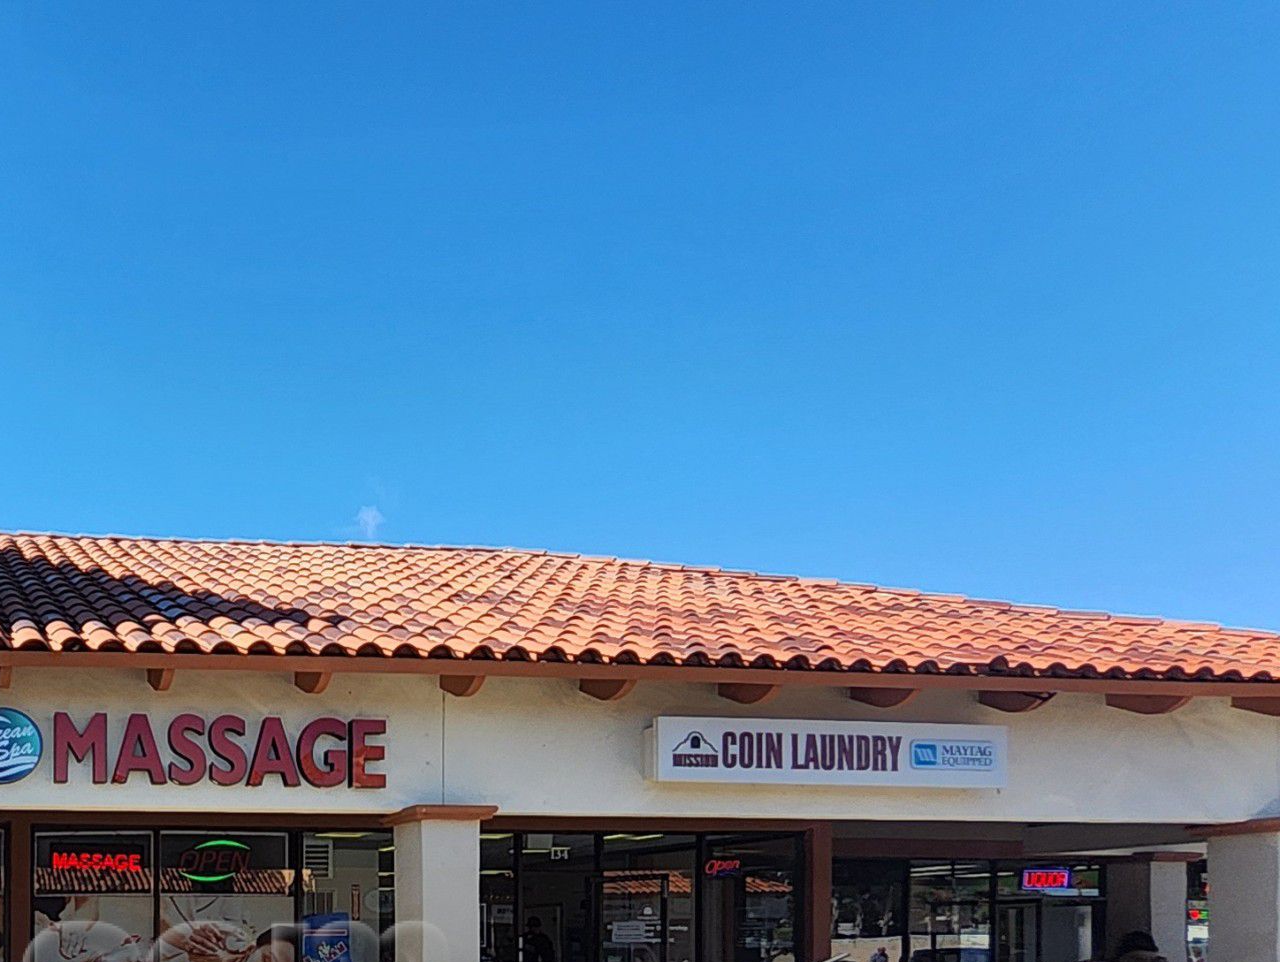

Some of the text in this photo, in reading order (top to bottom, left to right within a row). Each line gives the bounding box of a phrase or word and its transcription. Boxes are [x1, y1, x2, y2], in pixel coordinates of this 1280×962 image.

[53, 711, 388, 789] MASSAGE
[721, 731, 903, 772] COIN LAUNDRY
[941, 745, 993, 756] MAYTAG
[941, 756, 993, 766] EQUIPPED
[52, 851, 142, 872] MASSAGE
[179, 849, 251, 872] OPEN
[550, 849, 569, 860] 134
[1023, 872, 1067, 888] LIQUOR
